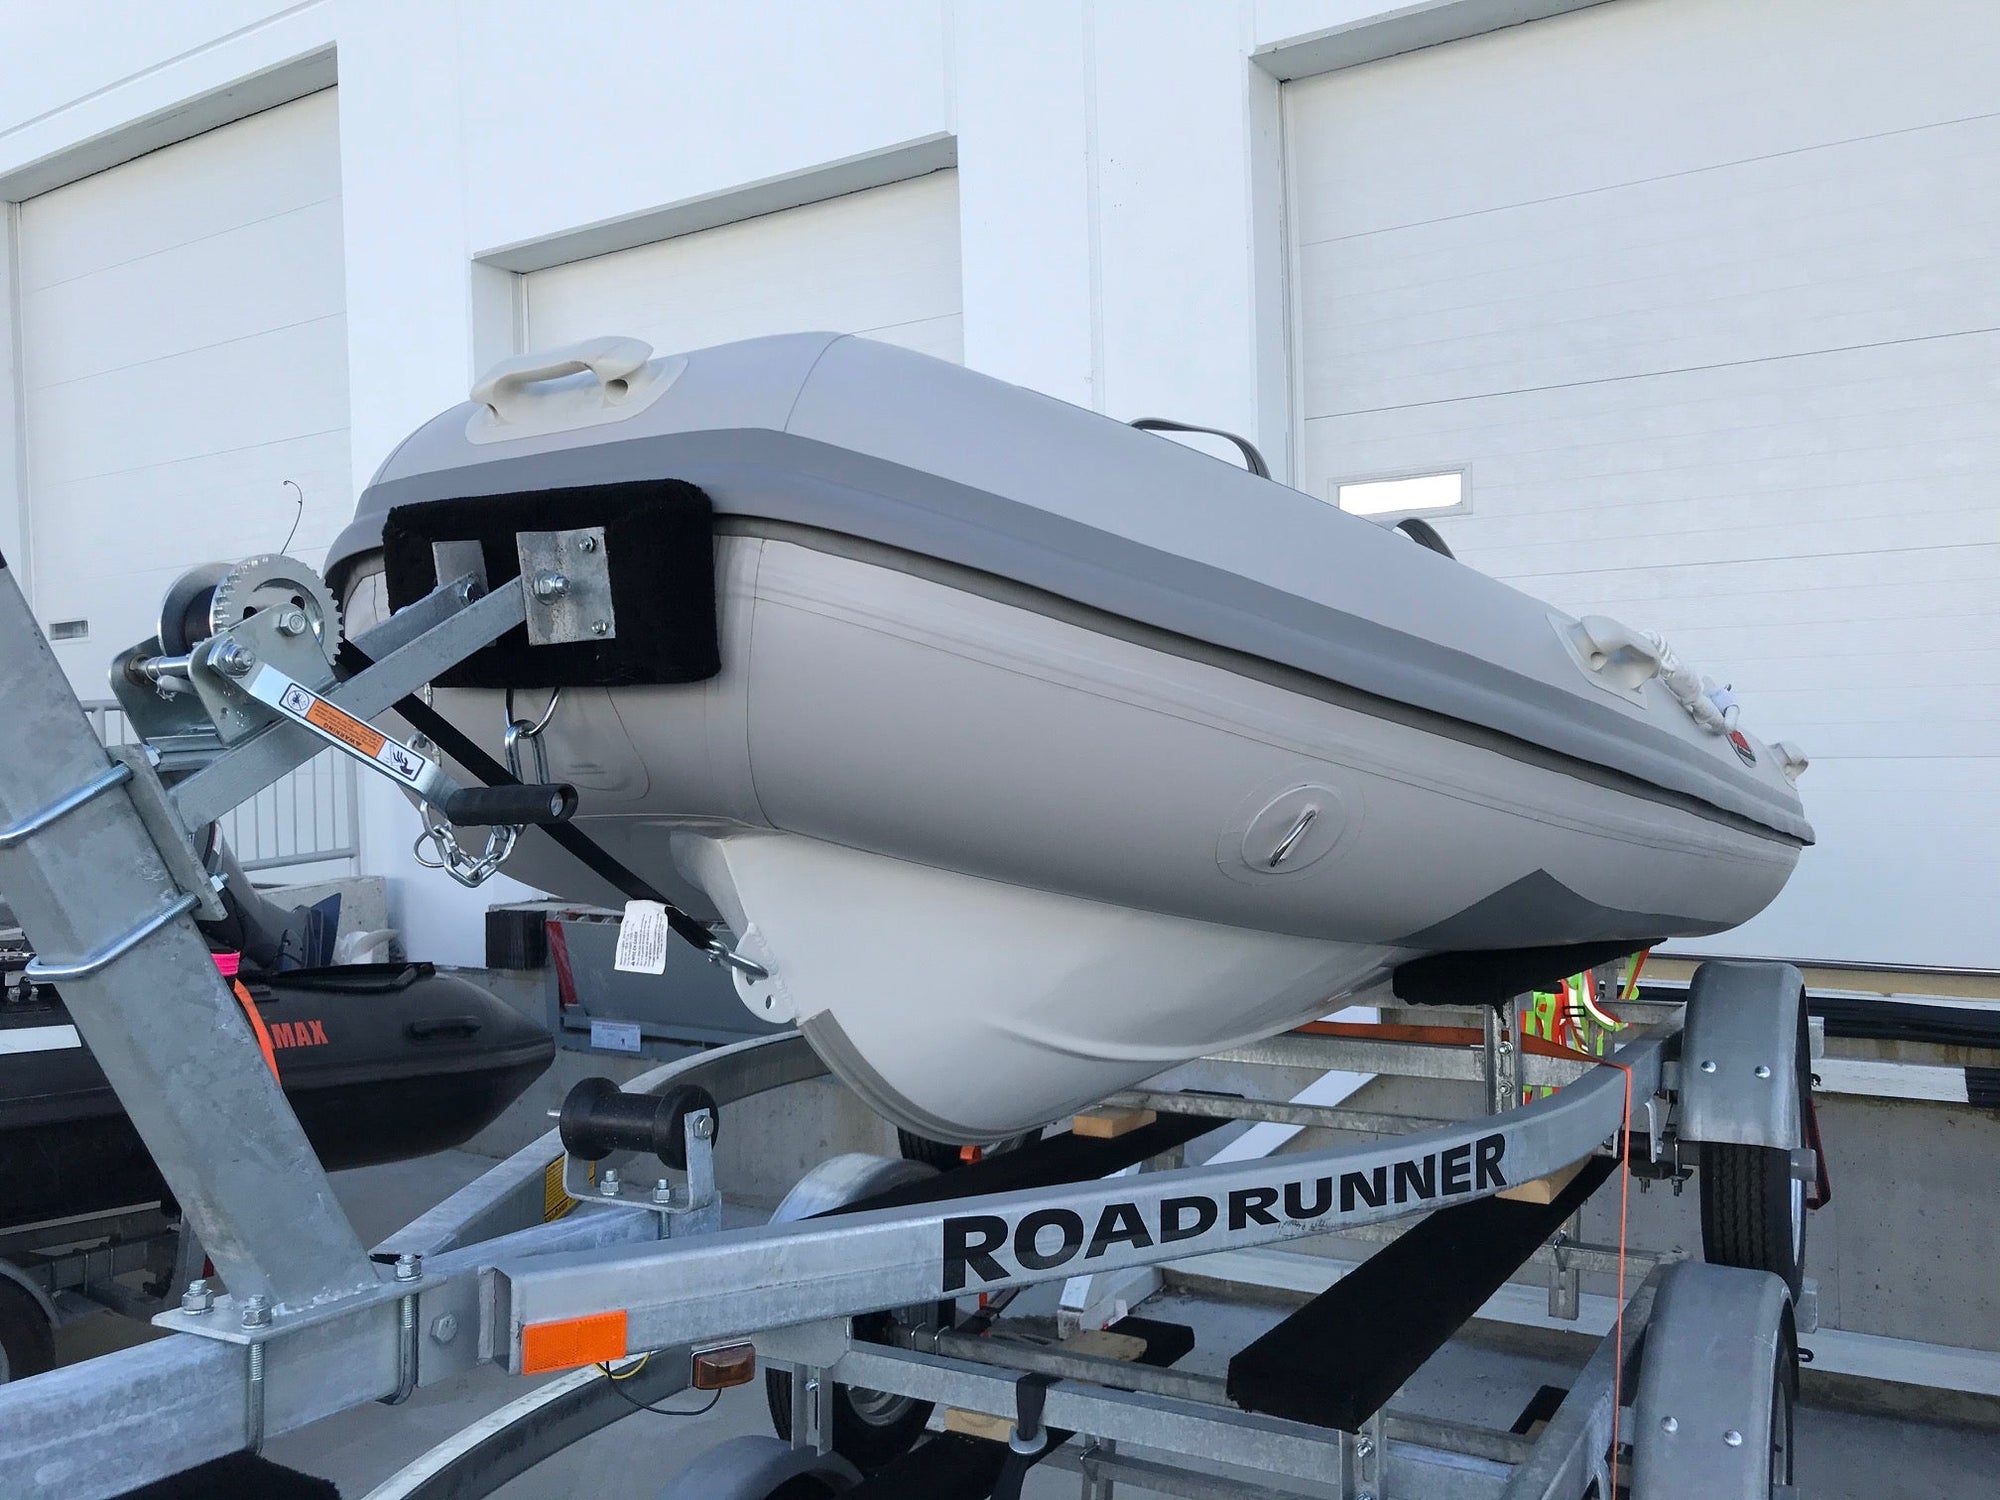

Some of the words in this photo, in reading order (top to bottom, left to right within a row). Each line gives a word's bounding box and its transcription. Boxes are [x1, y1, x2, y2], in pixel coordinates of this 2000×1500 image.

[323, 722, 355, 745] WARNING
[271, 1019, 329, 1049] MAX
[942, 1132, 1508, 1293] ROADRUNNER
